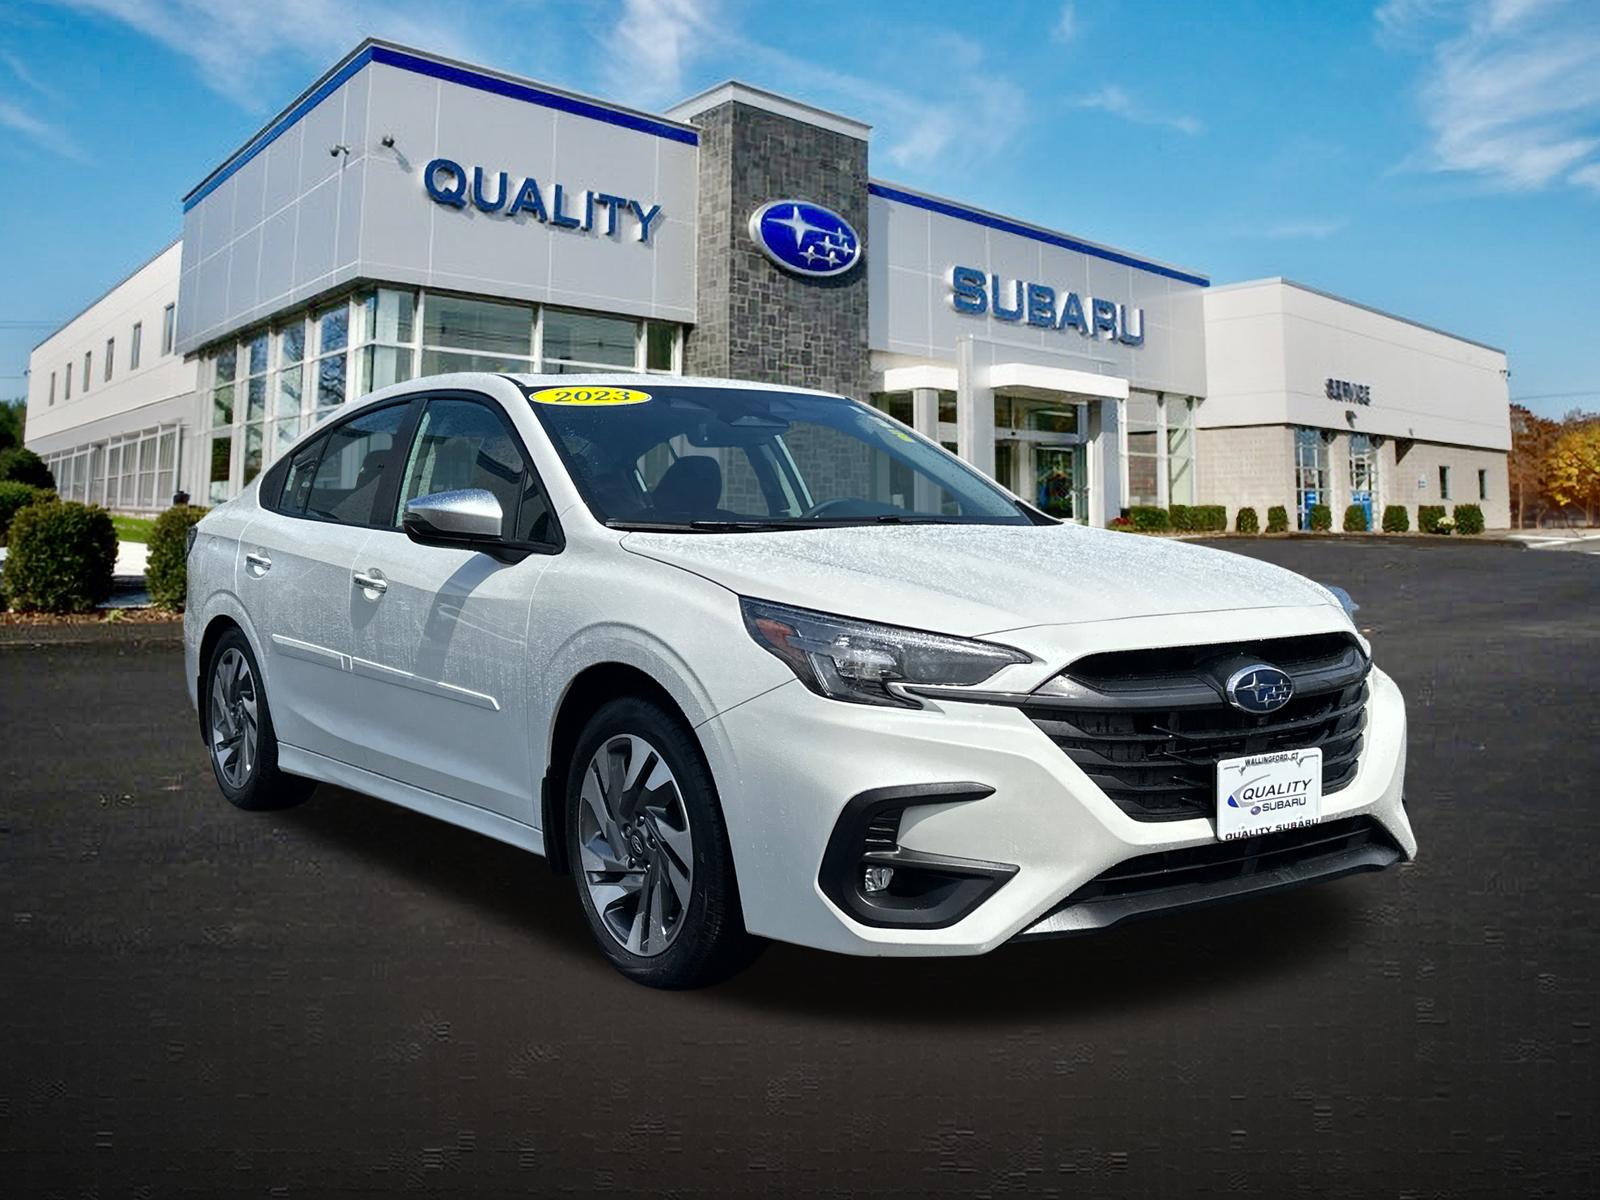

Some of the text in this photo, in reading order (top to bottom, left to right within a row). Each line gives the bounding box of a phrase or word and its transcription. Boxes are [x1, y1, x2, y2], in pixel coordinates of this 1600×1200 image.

[424, 158, 661, 243] QUALITY
[951, 265, 1145, 346] SUBARU
[554, 390, 631, 402] 2023
[1325, 378, 1371, 406] SERVICE
[1243, 779, 1312, 800] QUALITY
[1262, 797, 1306, 812] SUBARU
[1225, 817, 1319, 840] QUALITY SUBARU
